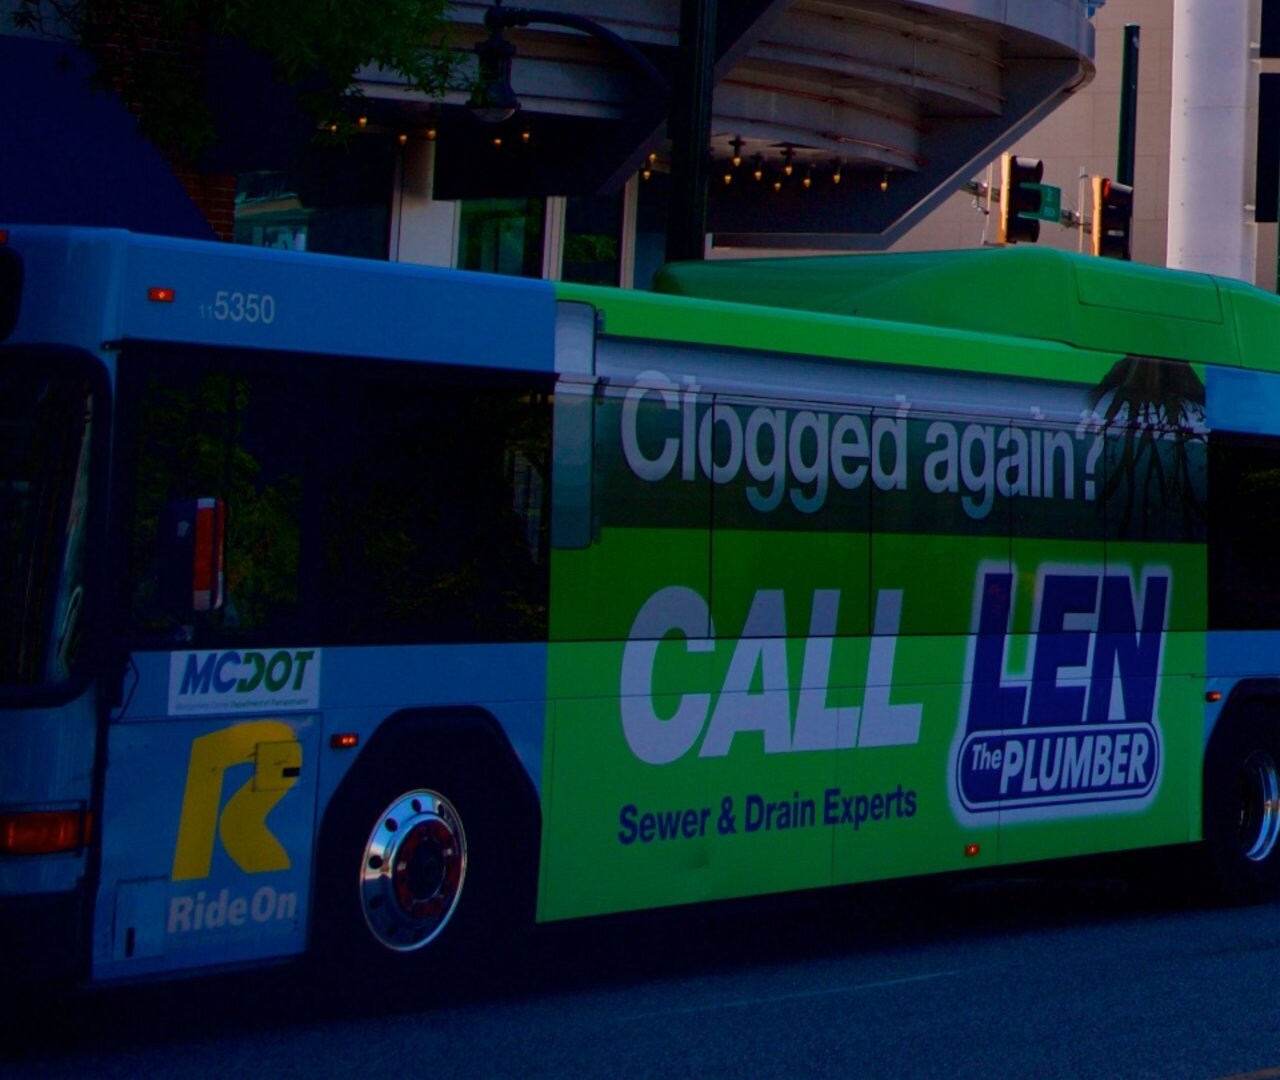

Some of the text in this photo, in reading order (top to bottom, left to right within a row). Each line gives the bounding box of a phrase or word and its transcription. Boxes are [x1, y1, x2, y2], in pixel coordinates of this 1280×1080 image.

[620, 370, 1106, 520] Clogged again?
[179, 651, 315, 695] MCDOT
[620, 585, 923, 765] CALL
[966, 573, 1168, 735] LEN
[618, 784, 917, 845] Sewer & Drain Experts
[971, 733, 1150, 794] The PLUMBER
